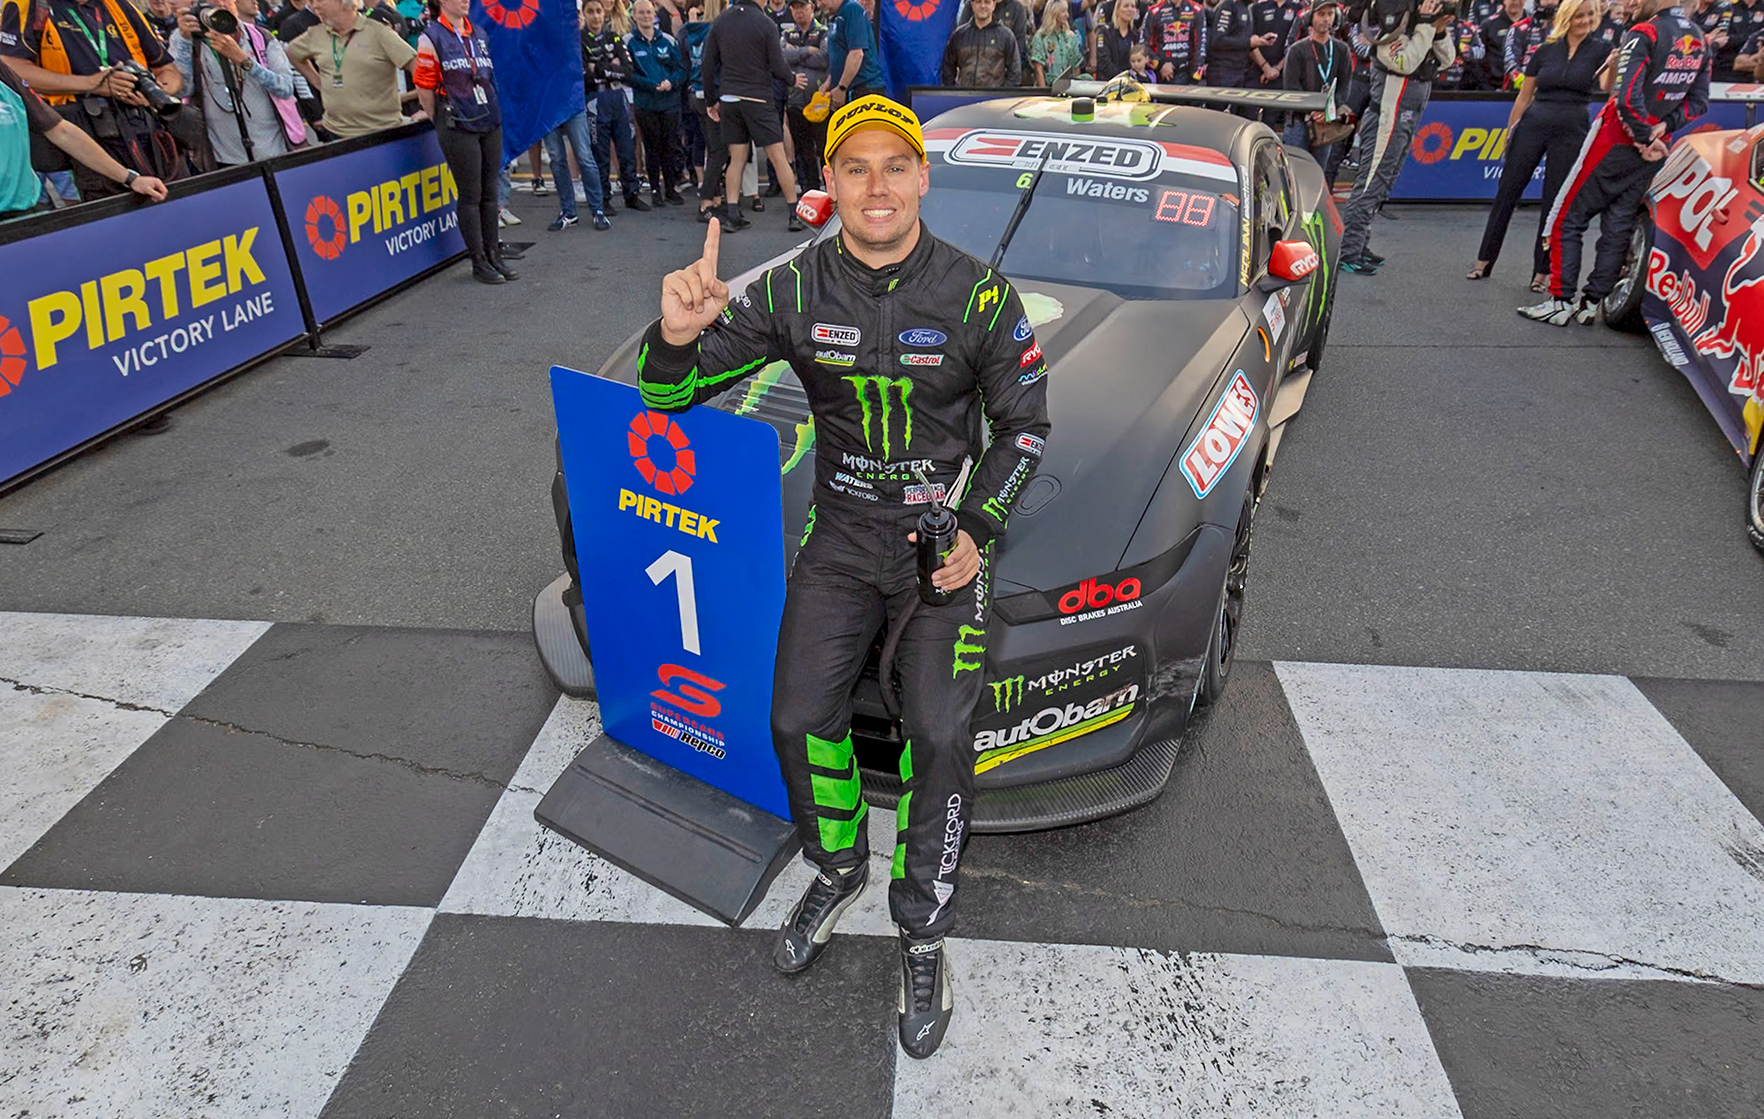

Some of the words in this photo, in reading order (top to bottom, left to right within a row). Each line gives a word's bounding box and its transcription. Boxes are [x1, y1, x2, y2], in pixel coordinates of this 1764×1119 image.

[1652, 71, 1697, 84] AMPO
[834, 103, 915, 131] DUNLOP
[1016, 140, 1144, 168] ENZED
[1066, 177, 1149, 203] Waters
[1154, 190, 1216, 227] 88
[385, 219, 436, 256] VICTORY
[1290, 252, 1320, 276] RYCO
[27, 227, 267, 371] PIRTEK
[112, 315, 215, 377] VICTORY
[221, 292, 275, 332] LANE
[828, 329, 856, 341] ENZED
[908, 331, 938, 344] Ford
[910, 355, 941, 365] Castrol
[1190, 379, 1256, 484] LOWES
[835, 472, 874, 489] WATERS
[619, 488, 721, 544] PIRTEK
[645, 550, 701, 656] 1
[1058, 577, 1141, 614] dba
[1060, 616, 1077, 626] DISC
[1078, 609, 1106, 622] BRAKES
[1108, 600, 1143, 615] AUSTRALIA
[1028, 645, 1137, 691] MONSTER
[1045, 664, 1121, 696] ENERGY
[650, 702, 725, 741] SUPERCARS
[651, 710, 726, 747] CHAMPIONSHIP
[680, 730, 726, 759] Repco
[938, 793, 962, 880] TICKFORD
